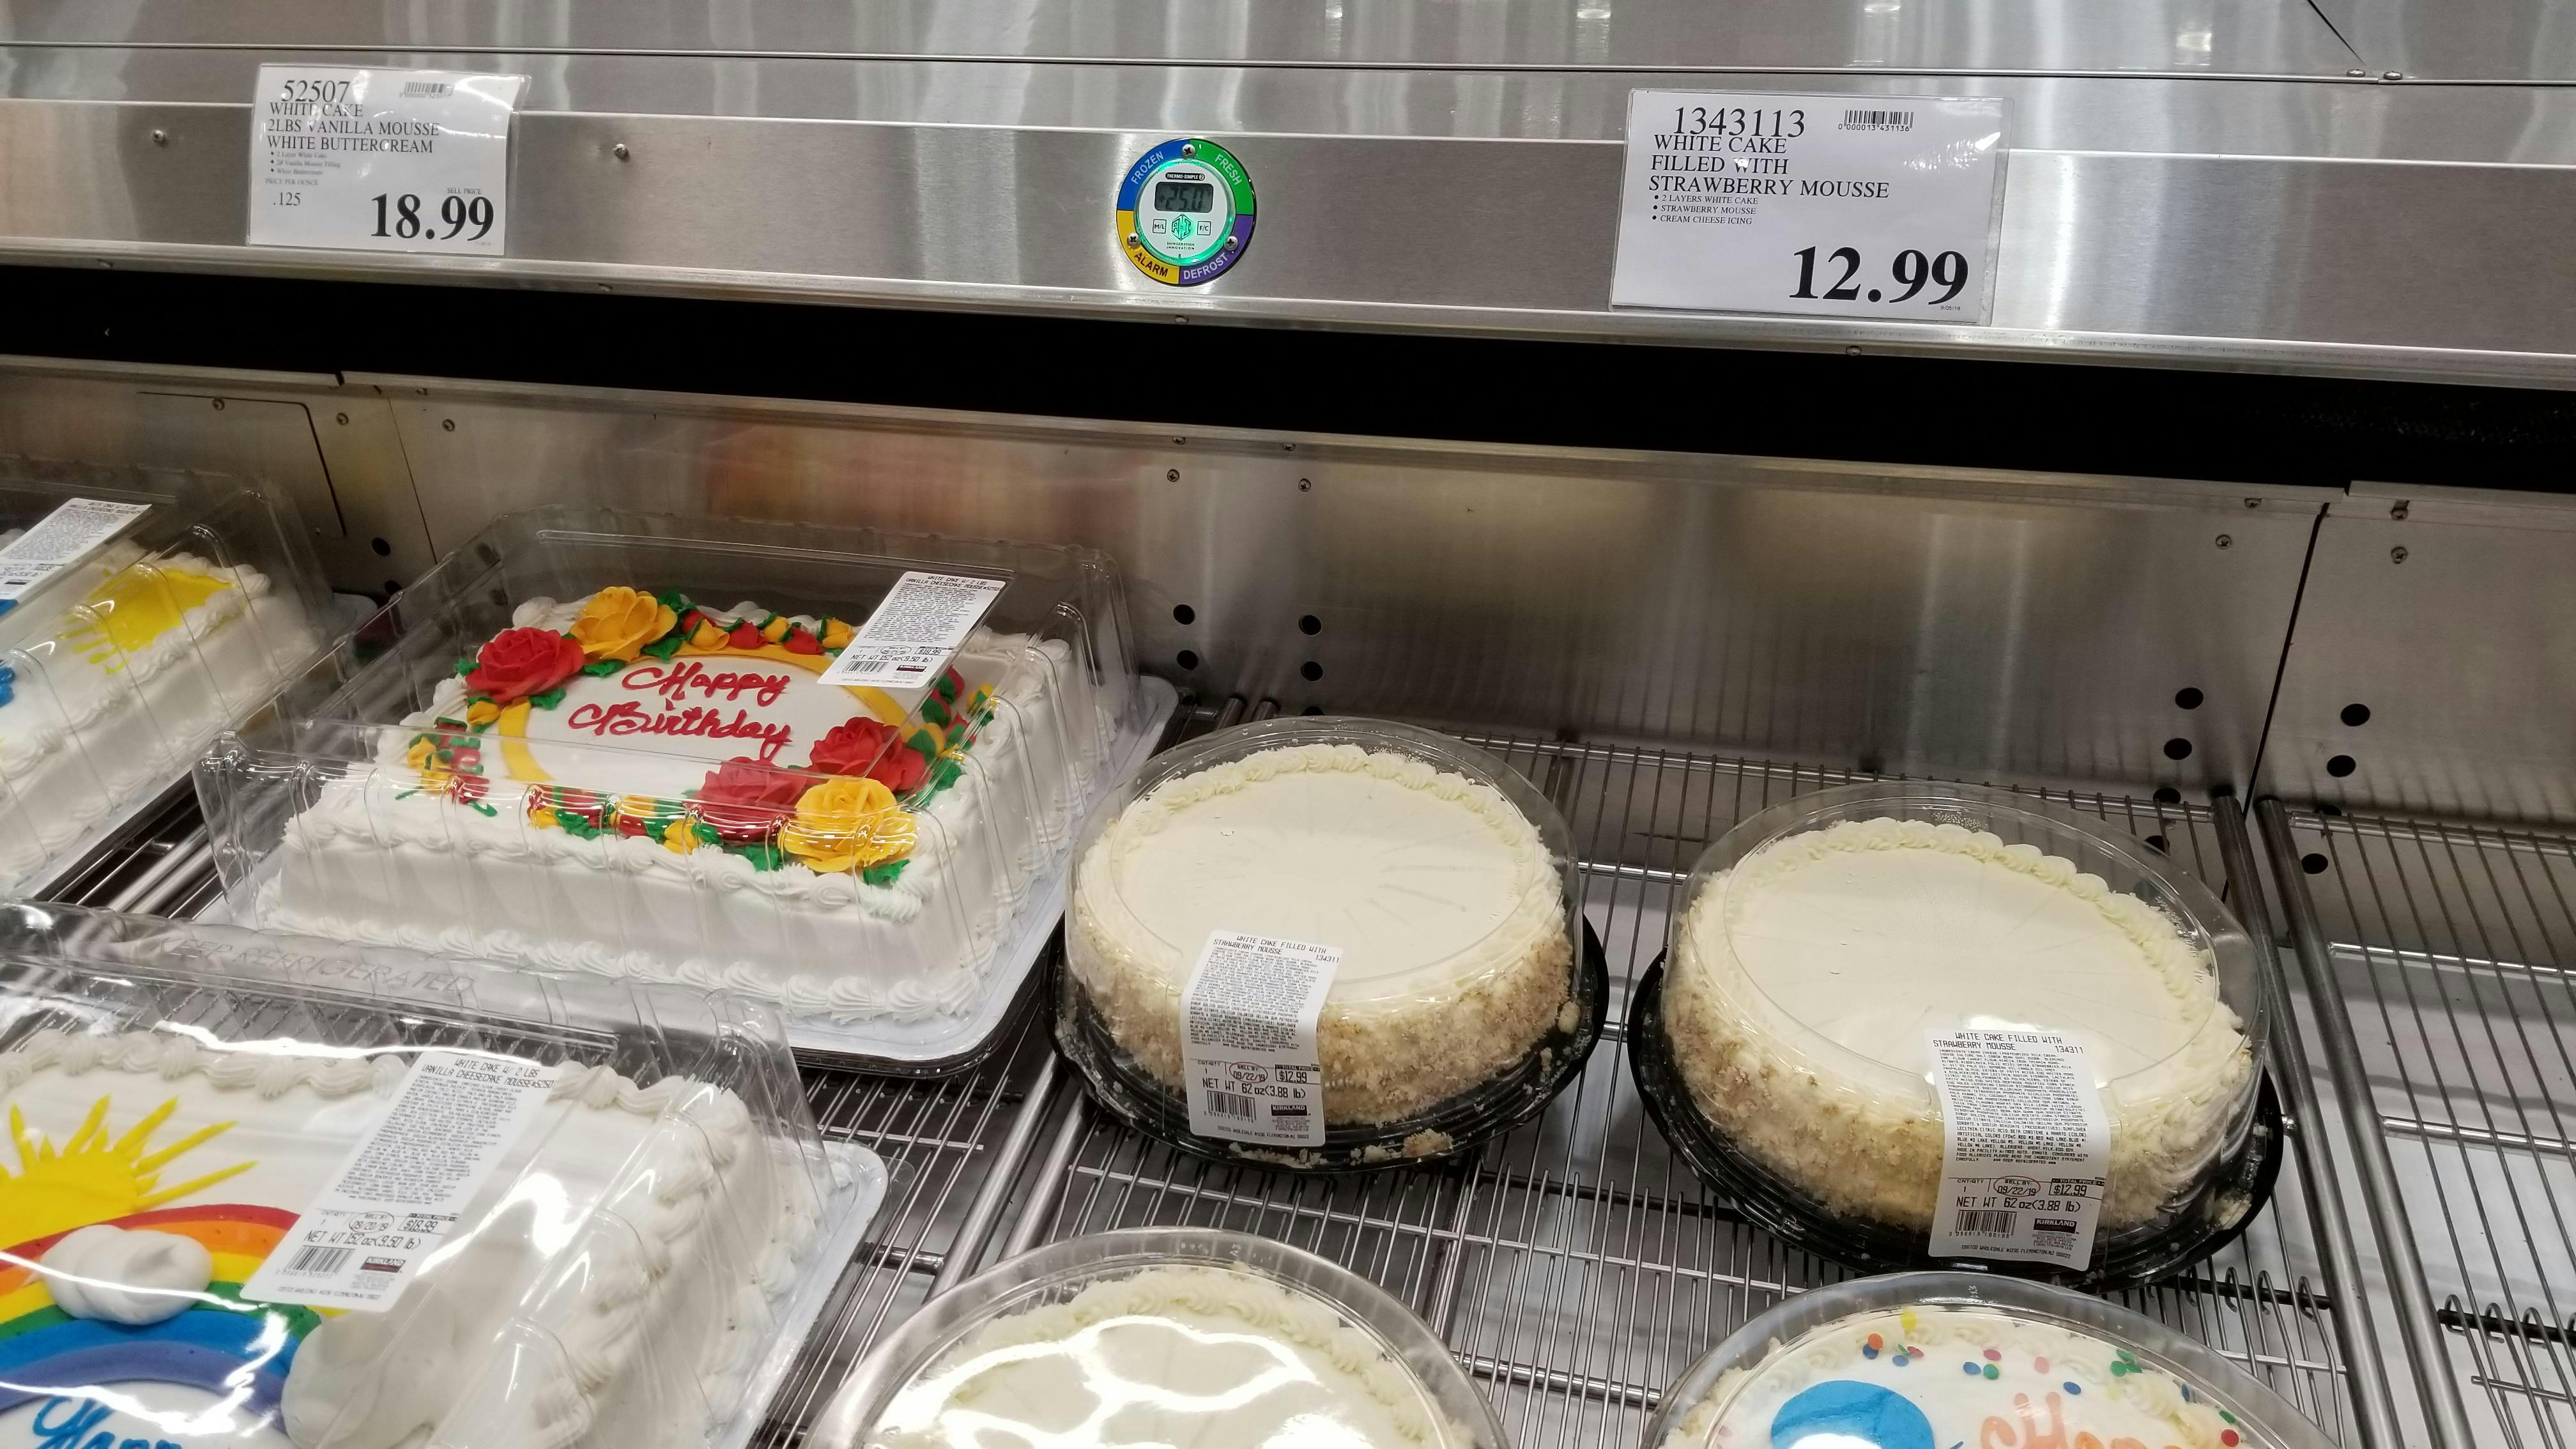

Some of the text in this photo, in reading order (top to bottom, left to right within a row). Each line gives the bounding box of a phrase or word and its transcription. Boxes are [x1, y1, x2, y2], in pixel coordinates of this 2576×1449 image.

[281, 80, 350, 103] 52507
[270, 102, 363, 118] WHITE CAKE
[268, 119, 440, 136] 2LBS VANILLA MOUSSE
[1673, 106, 1806, 139] 1343113
[268, 136, 433, 153] WHITE BUTTERCREAM
[1653, 134, 1788, 155] WHITE CAKE
[1131, 151, 1164, 185] FROZEN
[1215, 153, 1242, 185] FRESH
[1651, 155, 1789, 175] FILLED WITH
[1648, 175, 1890, 199] STRAWBERRY MOUSSE
[273, 192, 300, 206] .125
[371, 193, 494, 241] 18.99
[1661, 205, 1718, 213] STRAWBERRY
[1134, 252, 1169, 277] ALARM
[1183, 252, 1229, 280] DEFROST
[1789, 245, 1969, 305] 12.99
[622, 661, 792, 707] Happy
[568, 698, 794, 764] Birthday
[1213, 939, 1283, 954] STRAWBERRY MOUSSE
[1236, 935, 1327, 954] WHITE CAKE FILLED WITH
[1315, 954, 1340, 963] 134311
[1933, 1039, 2016, 1050] STRAWBERRY MOUSSE
[1955, 1032, 2062, 1044] WHITE CAKE FILLED WITH
[2055, 1046, 2084, 1054] 134311
[422, 1064, 455, 1076] VANILLA
[456, 1070, 502, 1084] CHEESECAKE
[454, 1058, 478, 1070] WHITE
[480, 1062, 500, 1072] CAKE
[524, 1068, 540, 1078] LBS
[1233, 1071, 1265, 1082] 09/22/19
[1279, 1071, 1307, 1083] $12.99
[1202, 1077, 1307, 1098] NET WT 62 oz(3.88 lb)
[1997, 1186, 2036, 1196] 09/22/19
[2053, 1184, 2087, 1196] $12.99
[1956, 1196, 2081, 1213] NET WT 62 oz(3.88 lb)
[403, 1220, 438, 1232] $18.99
[303, 1230, 328, 1242] NET
[328, 1232, 346, 1243] WT
[343, 1232, 365, 1245] 152
[404, 1238, 422, 1250] lb)
